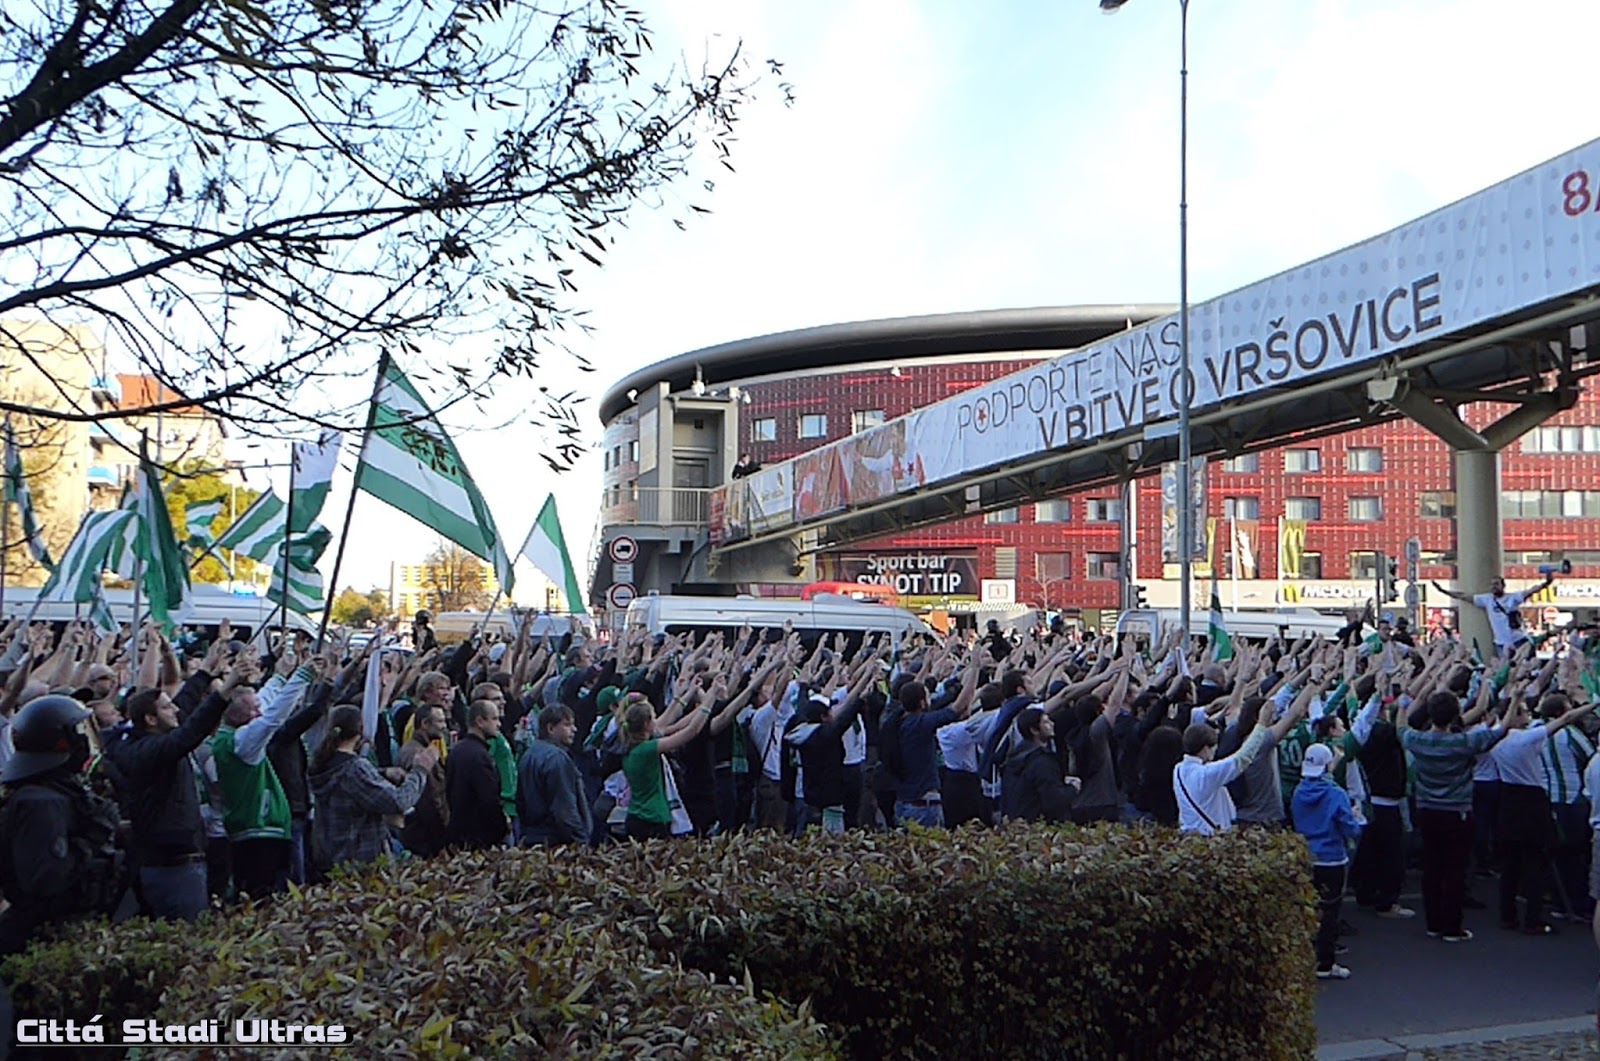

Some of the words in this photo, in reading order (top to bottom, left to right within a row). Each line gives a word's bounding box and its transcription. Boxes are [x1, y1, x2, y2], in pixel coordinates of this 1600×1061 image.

[1039, 411, 1059, 449] V
[1066, 364, 1161, 445] BITVĚ
[1169, 366, 1196, 410] O
[1204, 271, 1443, 397] VRŠOVICE
[957, 351, 1102, 440] PODPOŘTE
[867, 553, 913, 574] Sport
[917, 551, 947, 570] bar
[928, 573, 962, 593] TIP
[1556, 584, 1600, 597] McD
